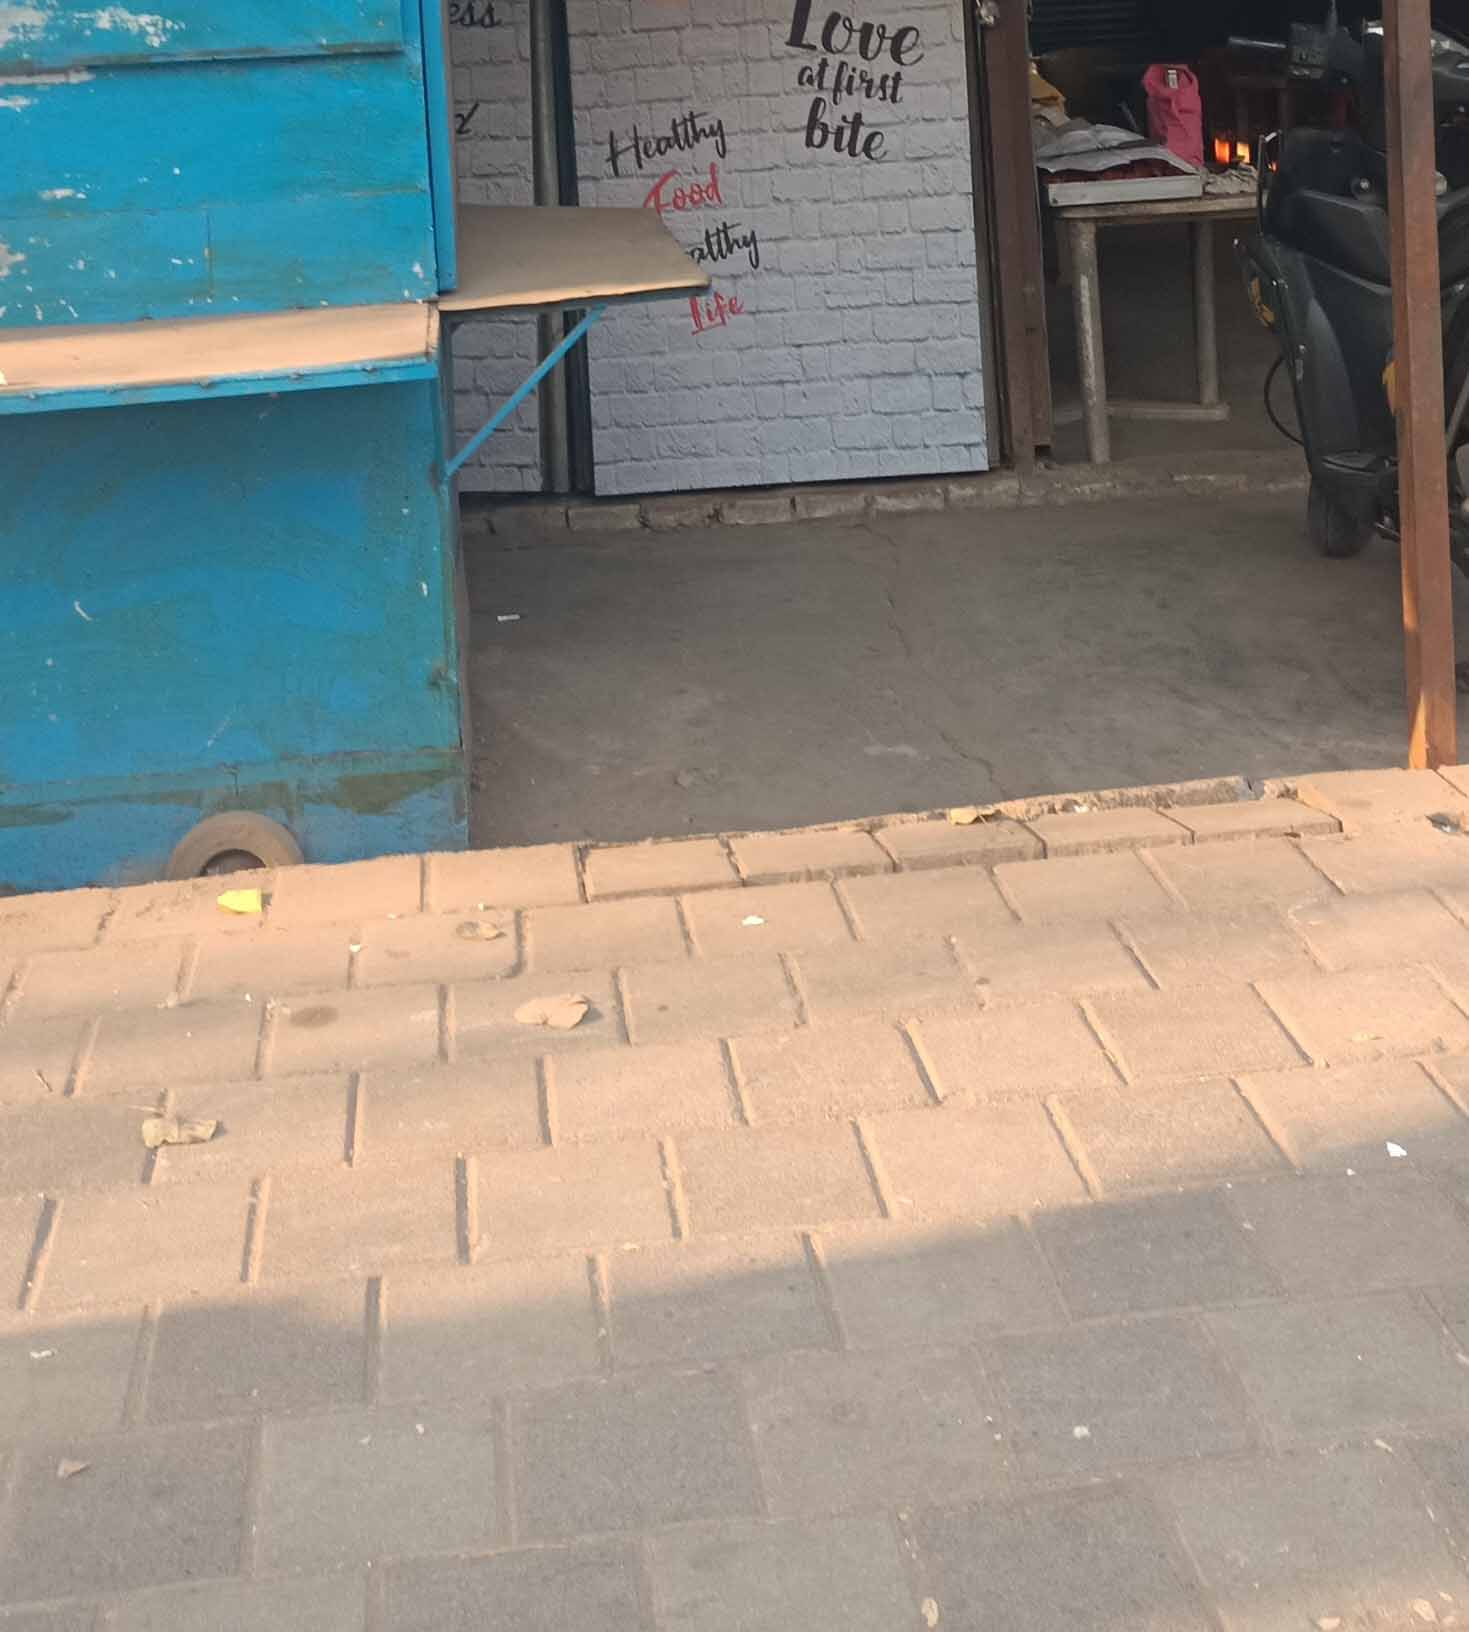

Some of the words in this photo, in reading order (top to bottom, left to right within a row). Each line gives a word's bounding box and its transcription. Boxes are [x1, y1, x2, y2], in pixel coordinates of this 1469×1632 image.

[797, 57, 830, 91] at
[832, 60, 904, 106] first
[605, 110, 727, 177] Healthy
[804, 96, 889, 161] bite
[643, 161, 722, 216] Food
